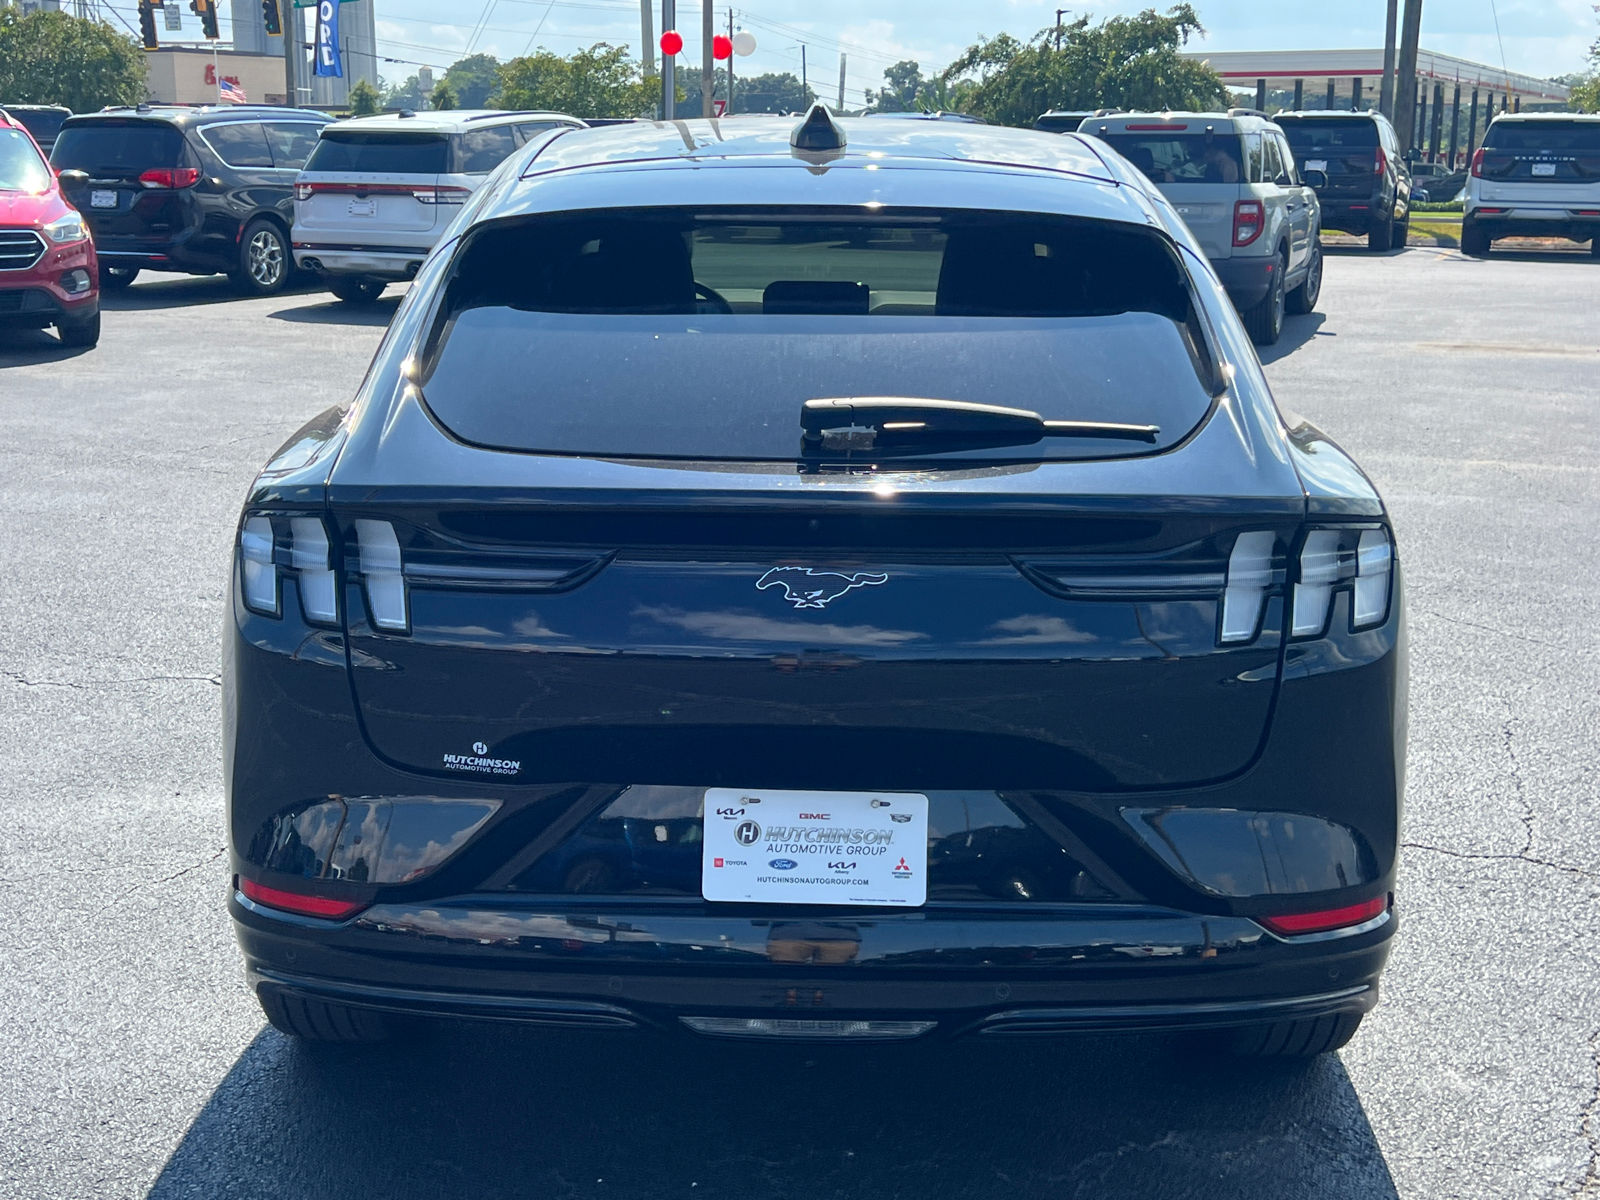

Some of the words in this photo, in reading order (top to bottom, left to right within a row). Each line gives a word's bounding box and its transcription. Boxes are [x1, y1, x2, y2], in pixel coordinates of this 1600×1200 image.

[443, 754, 521, 769] HUTCHINSON
[445, 763, 491, 773] AUTOMOTIVE
[492, 767, 518, 775] GROUP
[764, 826, 894, 845] HUTCHINSON
[766, 844, 842, 855] AUTOMOTIVE
[846, 845, 887, 856] GROUP
[771, 859, 795, 869] Ford
[757, 876, 869, 885] HUTCHINSONAUTOGROUP.COM
